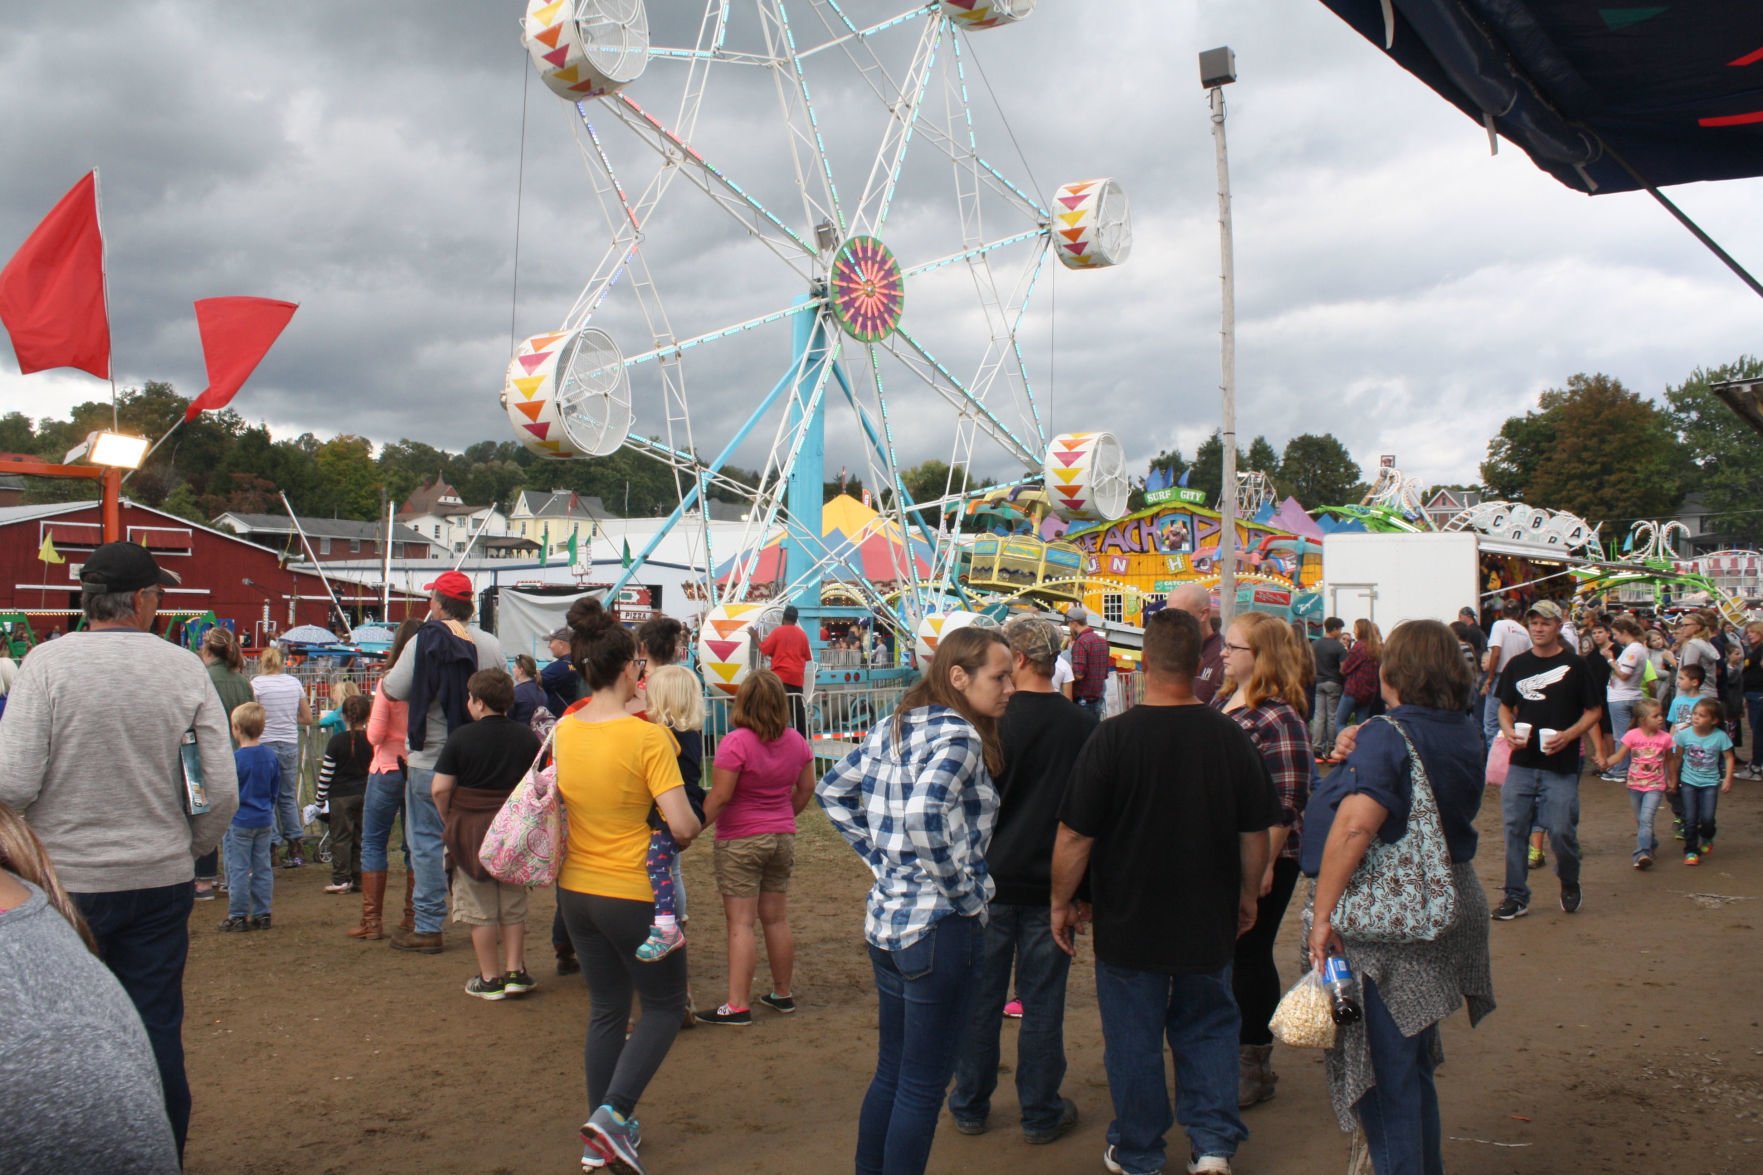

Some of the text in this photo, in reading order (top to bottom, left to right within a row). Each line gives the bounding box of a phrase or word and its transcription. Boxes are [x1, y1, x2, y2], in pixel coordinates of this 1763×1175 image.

[1147, 490, 1202, 502] SURF CITY
[1076, 515, 1160, 554] EACH
[625, 612, 647, 620] PIZZA
